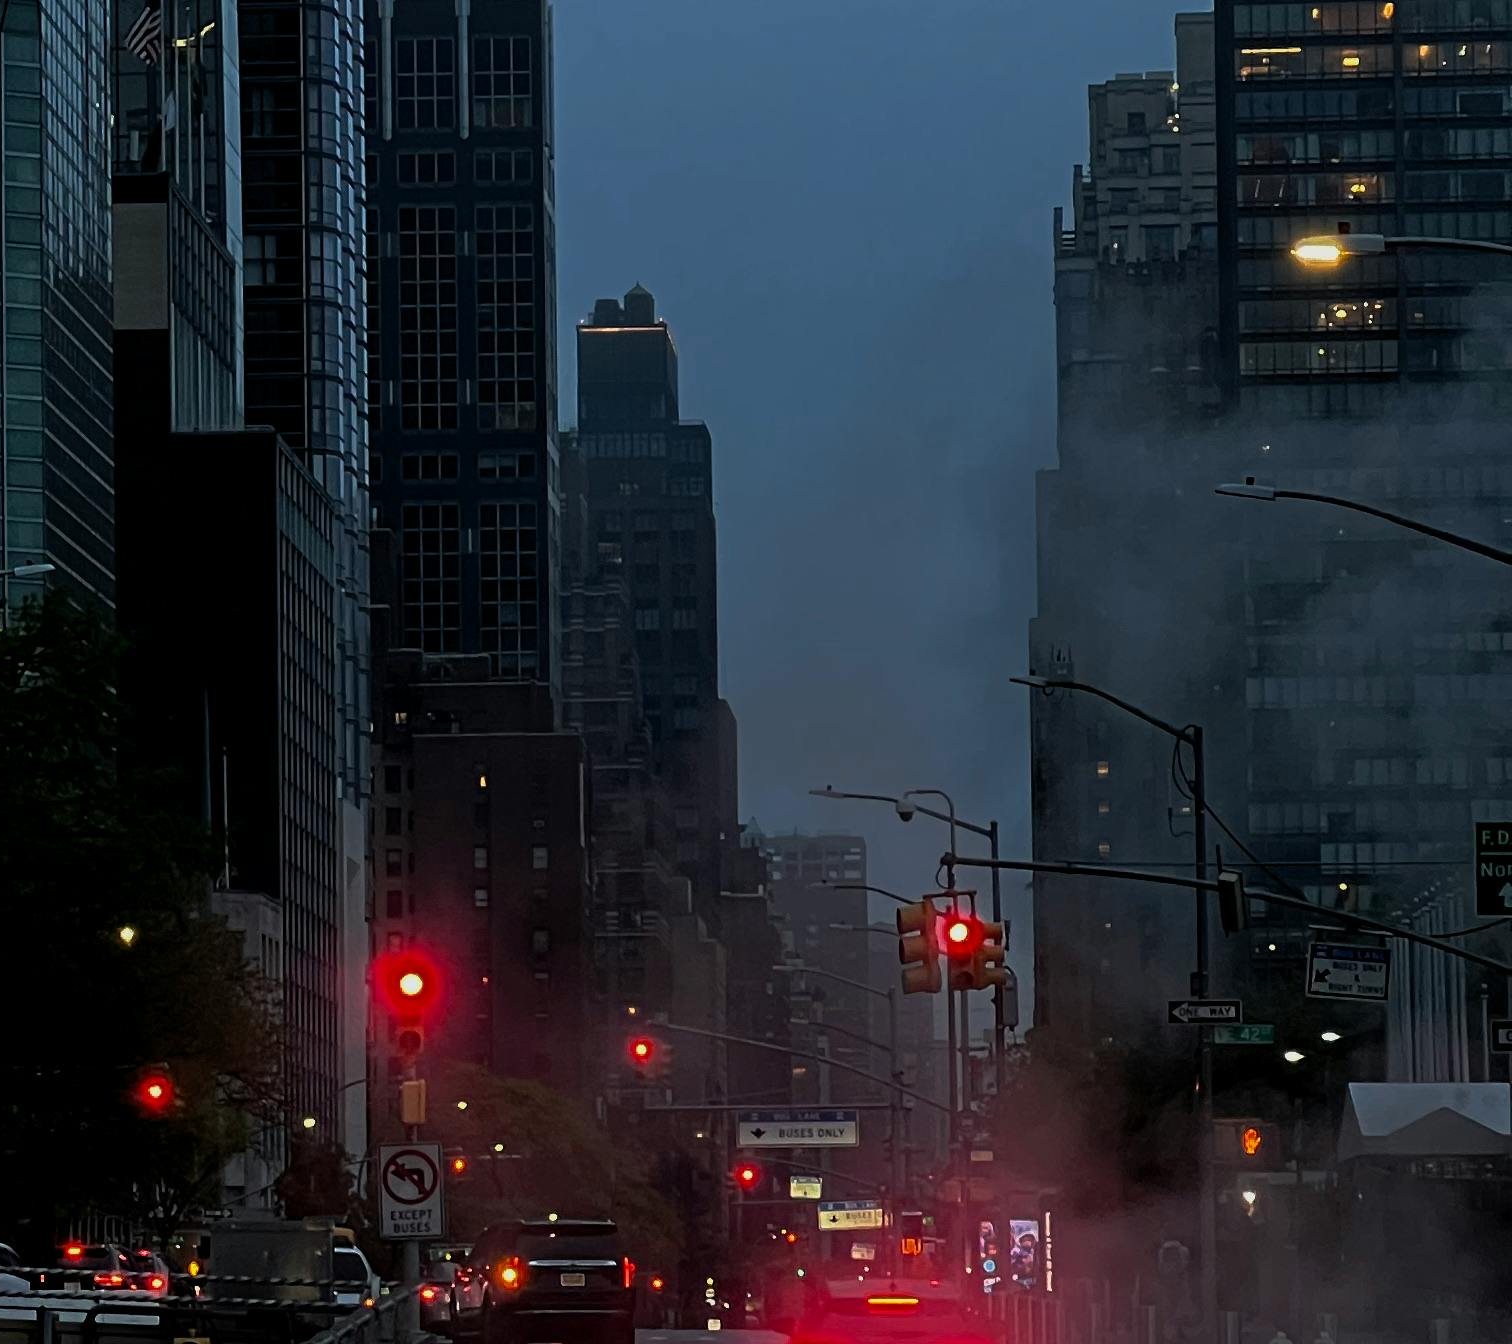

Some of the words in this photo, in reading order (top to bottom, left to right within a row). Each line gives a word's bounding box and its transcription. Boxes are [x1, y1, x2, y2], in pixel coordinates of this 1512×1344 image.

[1482, 830, 1512, 846] F.D
[1179, 1007, 1199, 1017] ONE
[1209, 1007, 1232, 1017] WAY
[778, 1128, 814, 1138] BUSES
[818, 1128, 845, 1138] ONLY
[390, 1209, 432, 1221] EXCEPT
[393, 1223, 431, 1233] BUSES
